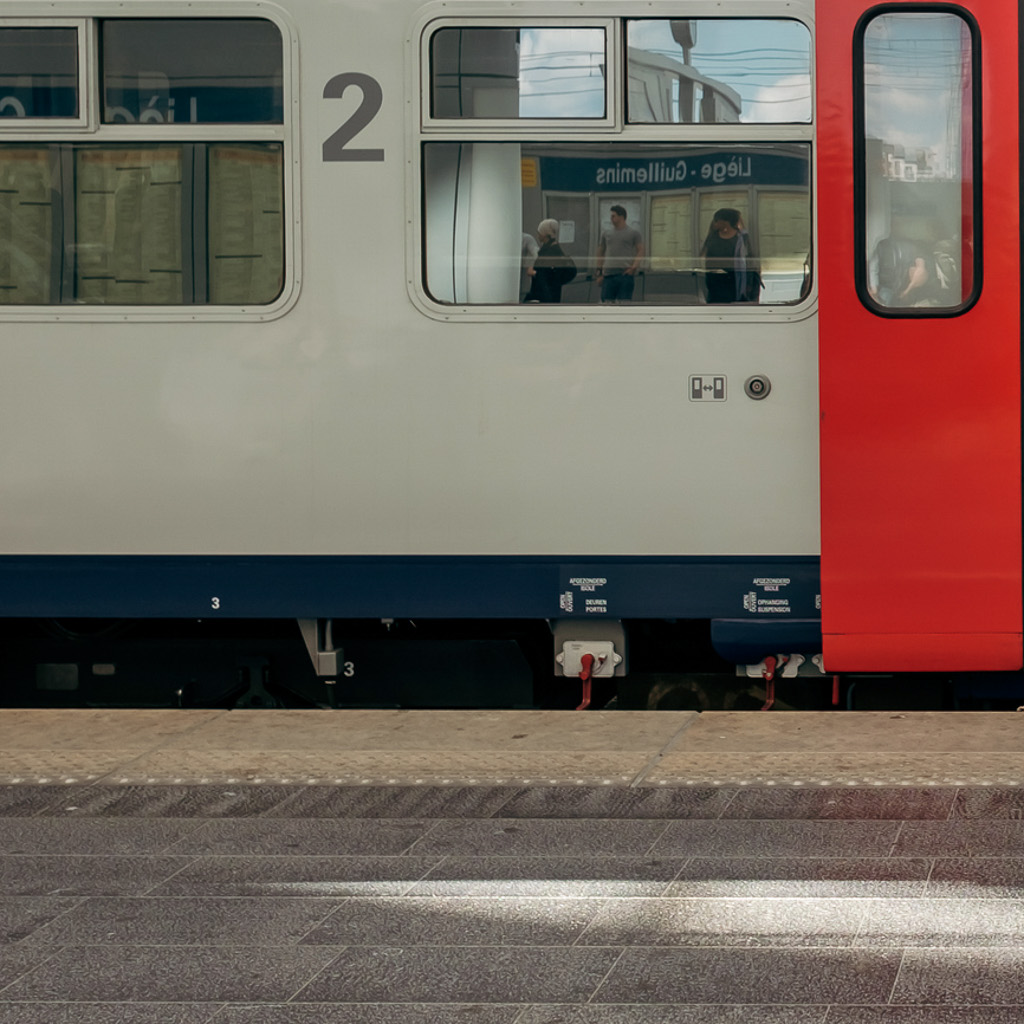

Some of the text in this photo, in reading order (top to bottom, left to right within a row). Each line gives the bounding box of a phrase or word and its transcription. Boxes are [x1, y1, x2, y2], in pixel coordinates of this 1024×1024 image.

[322, 72, 384, 162] 2
[212, 596, 220, 609] 3
[343, 661, 355, 677] 3
